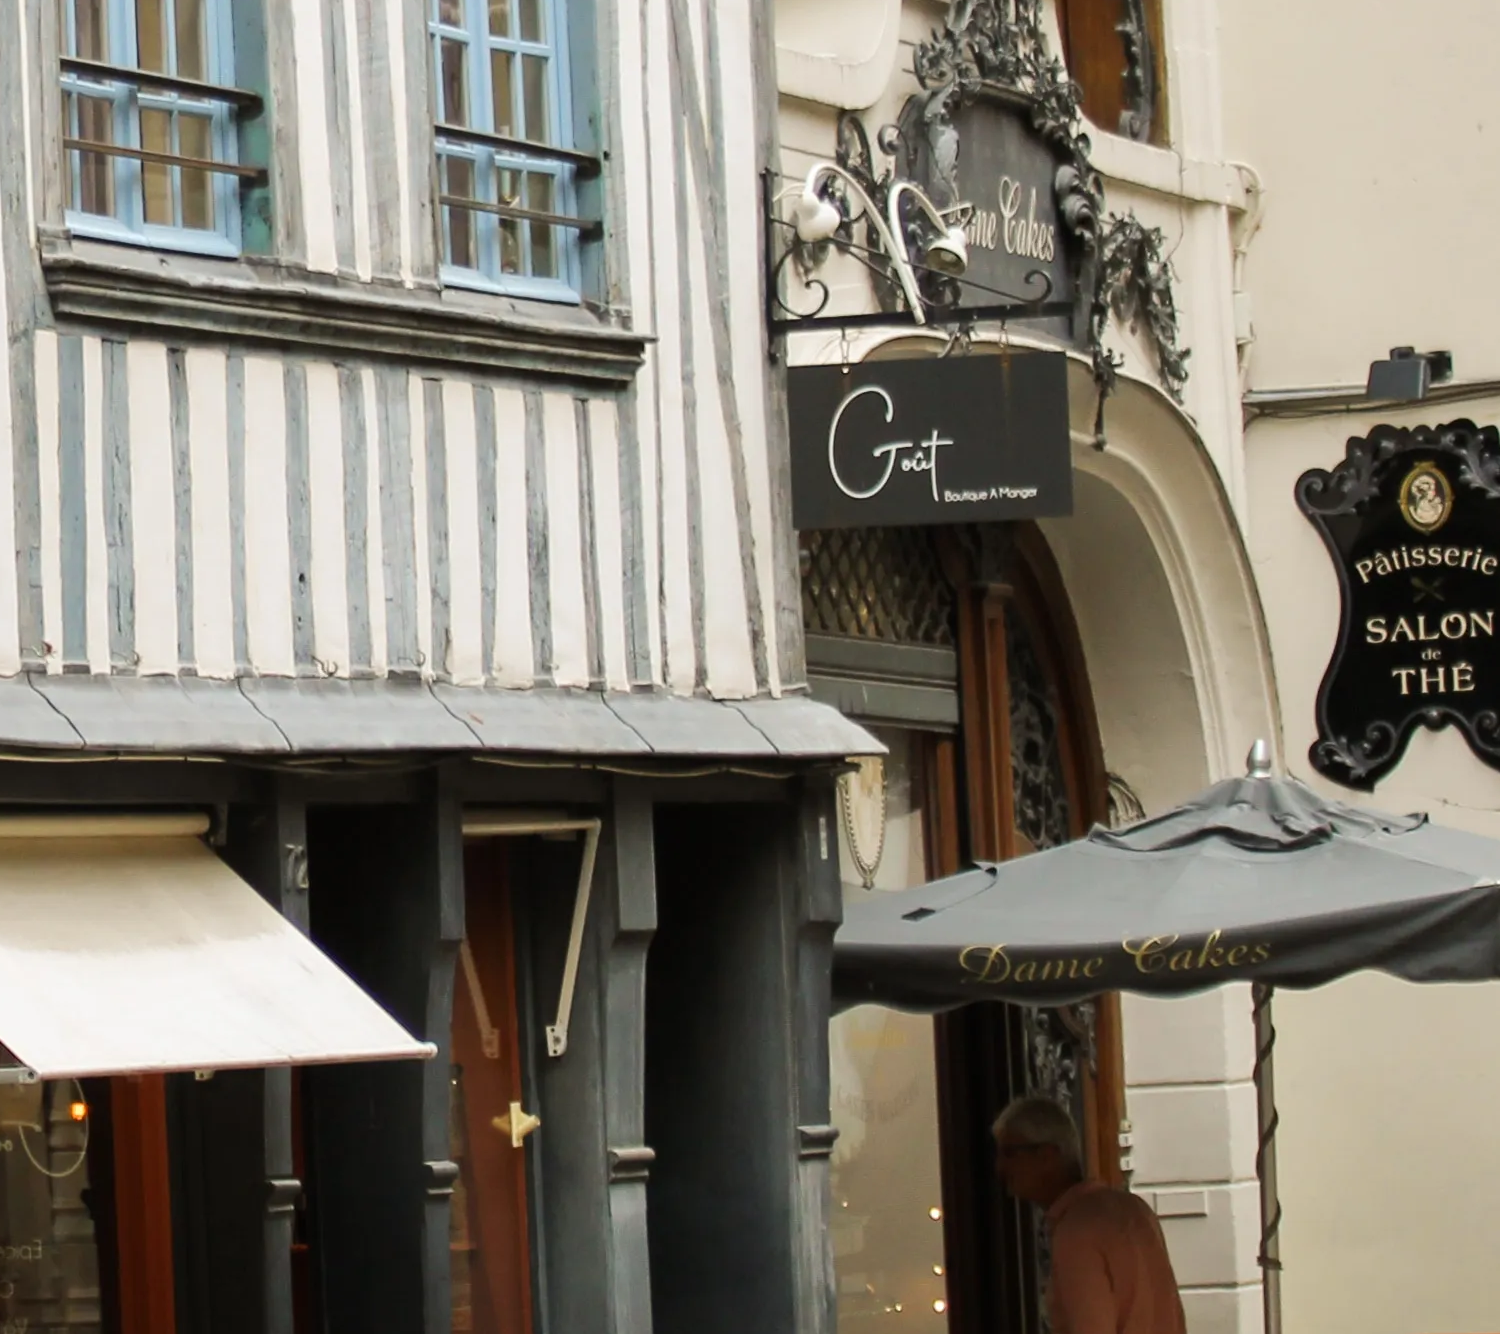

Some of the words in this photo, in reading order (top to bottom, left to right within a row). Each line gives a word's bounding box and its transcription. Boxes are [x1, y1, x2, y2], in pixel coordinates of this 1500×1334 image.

[999, 176, 1055, 262] Cakes
[828, 385, 954, 502] Goût
[944, 489, 987, 502] Boutique
[1354, 543, 1499, 584] Pâtisserie
[1366, 612, 1495, 644] SALON
[1421, 647, 1442, 661] de
[1392, 662, 1476, 695] THÉ
[958, 942, 1104, 987] Dame
[1122, 928, 1273, 977] Cakes
